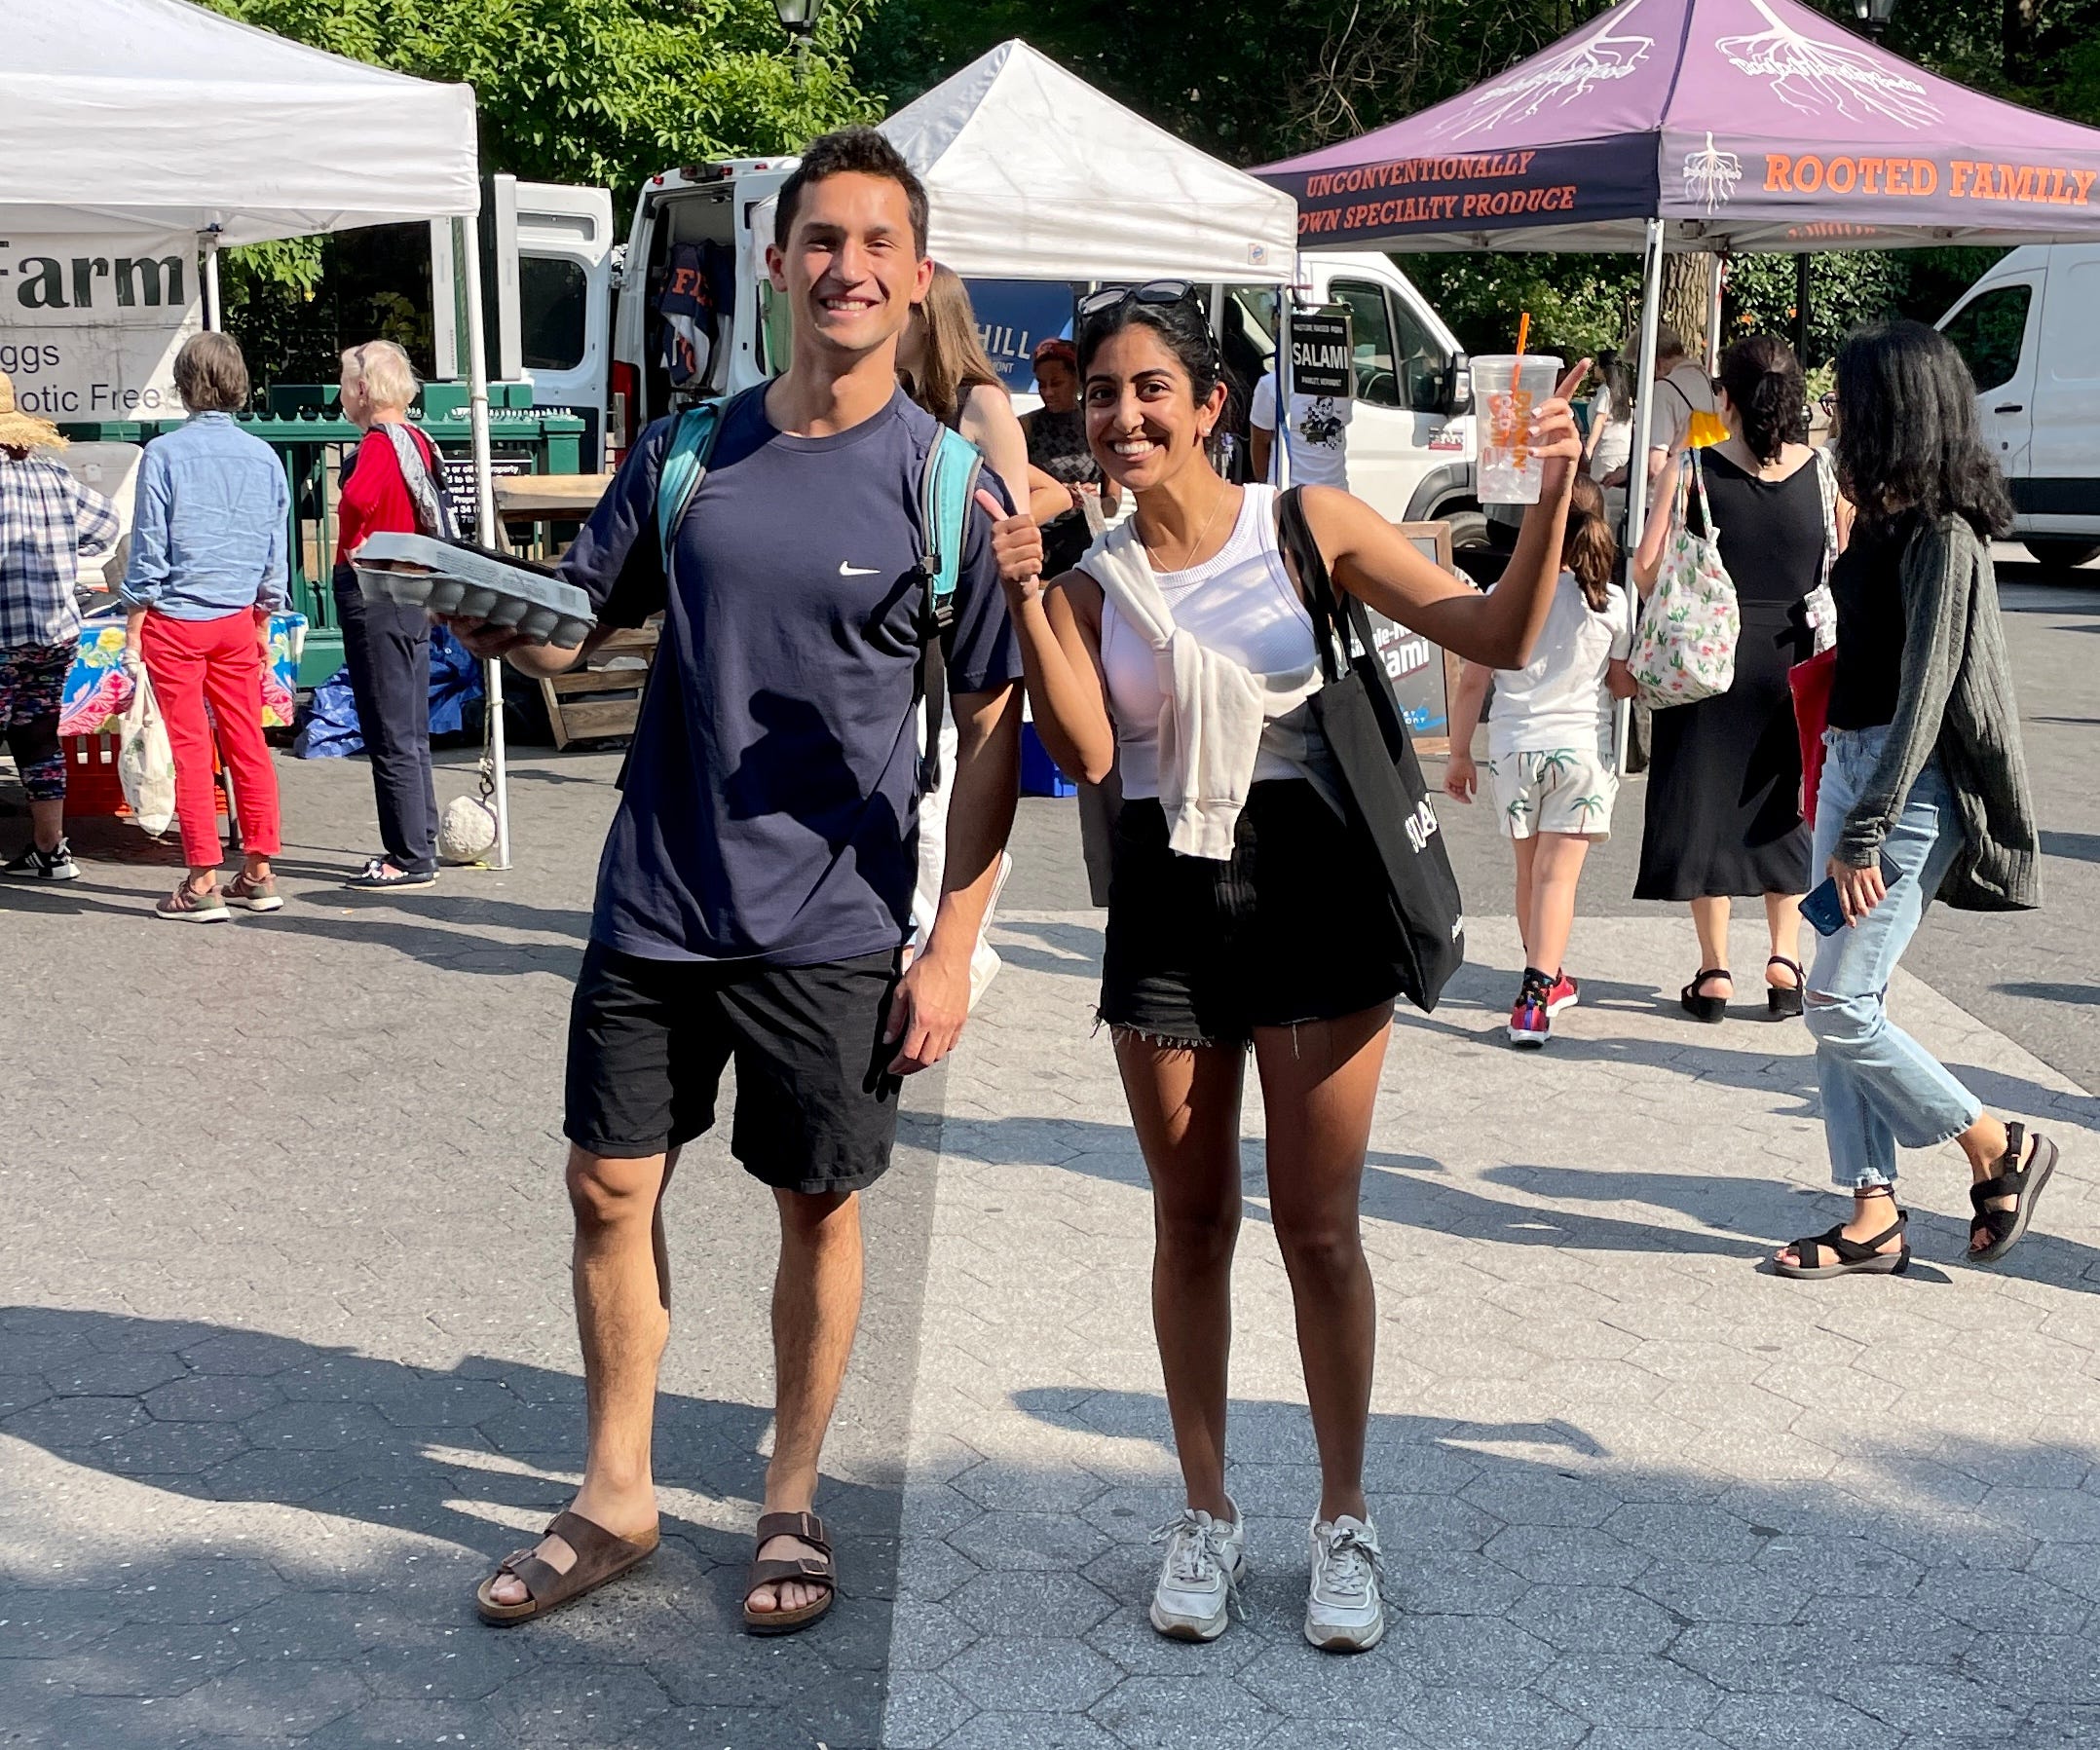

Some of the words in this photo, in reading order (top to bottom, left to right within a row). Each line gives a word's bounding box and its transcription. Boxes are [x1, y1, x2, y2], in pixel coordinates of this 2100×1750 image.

[1305, 150, 1536, 199] UNCONVENTIONALLY
[1763, 153, 1939, 197] ROOTED
[1948, 159, 2098, 206] FAMILY
[1343, 195, 1459, 230] SPECIALTY
[1462, 185, 1578, 218] PRODUCE
[0, 241, 185, 309] arm
[1292, 342, 1349, 370] SALAMI
[91, 384, 160, 412] Free
